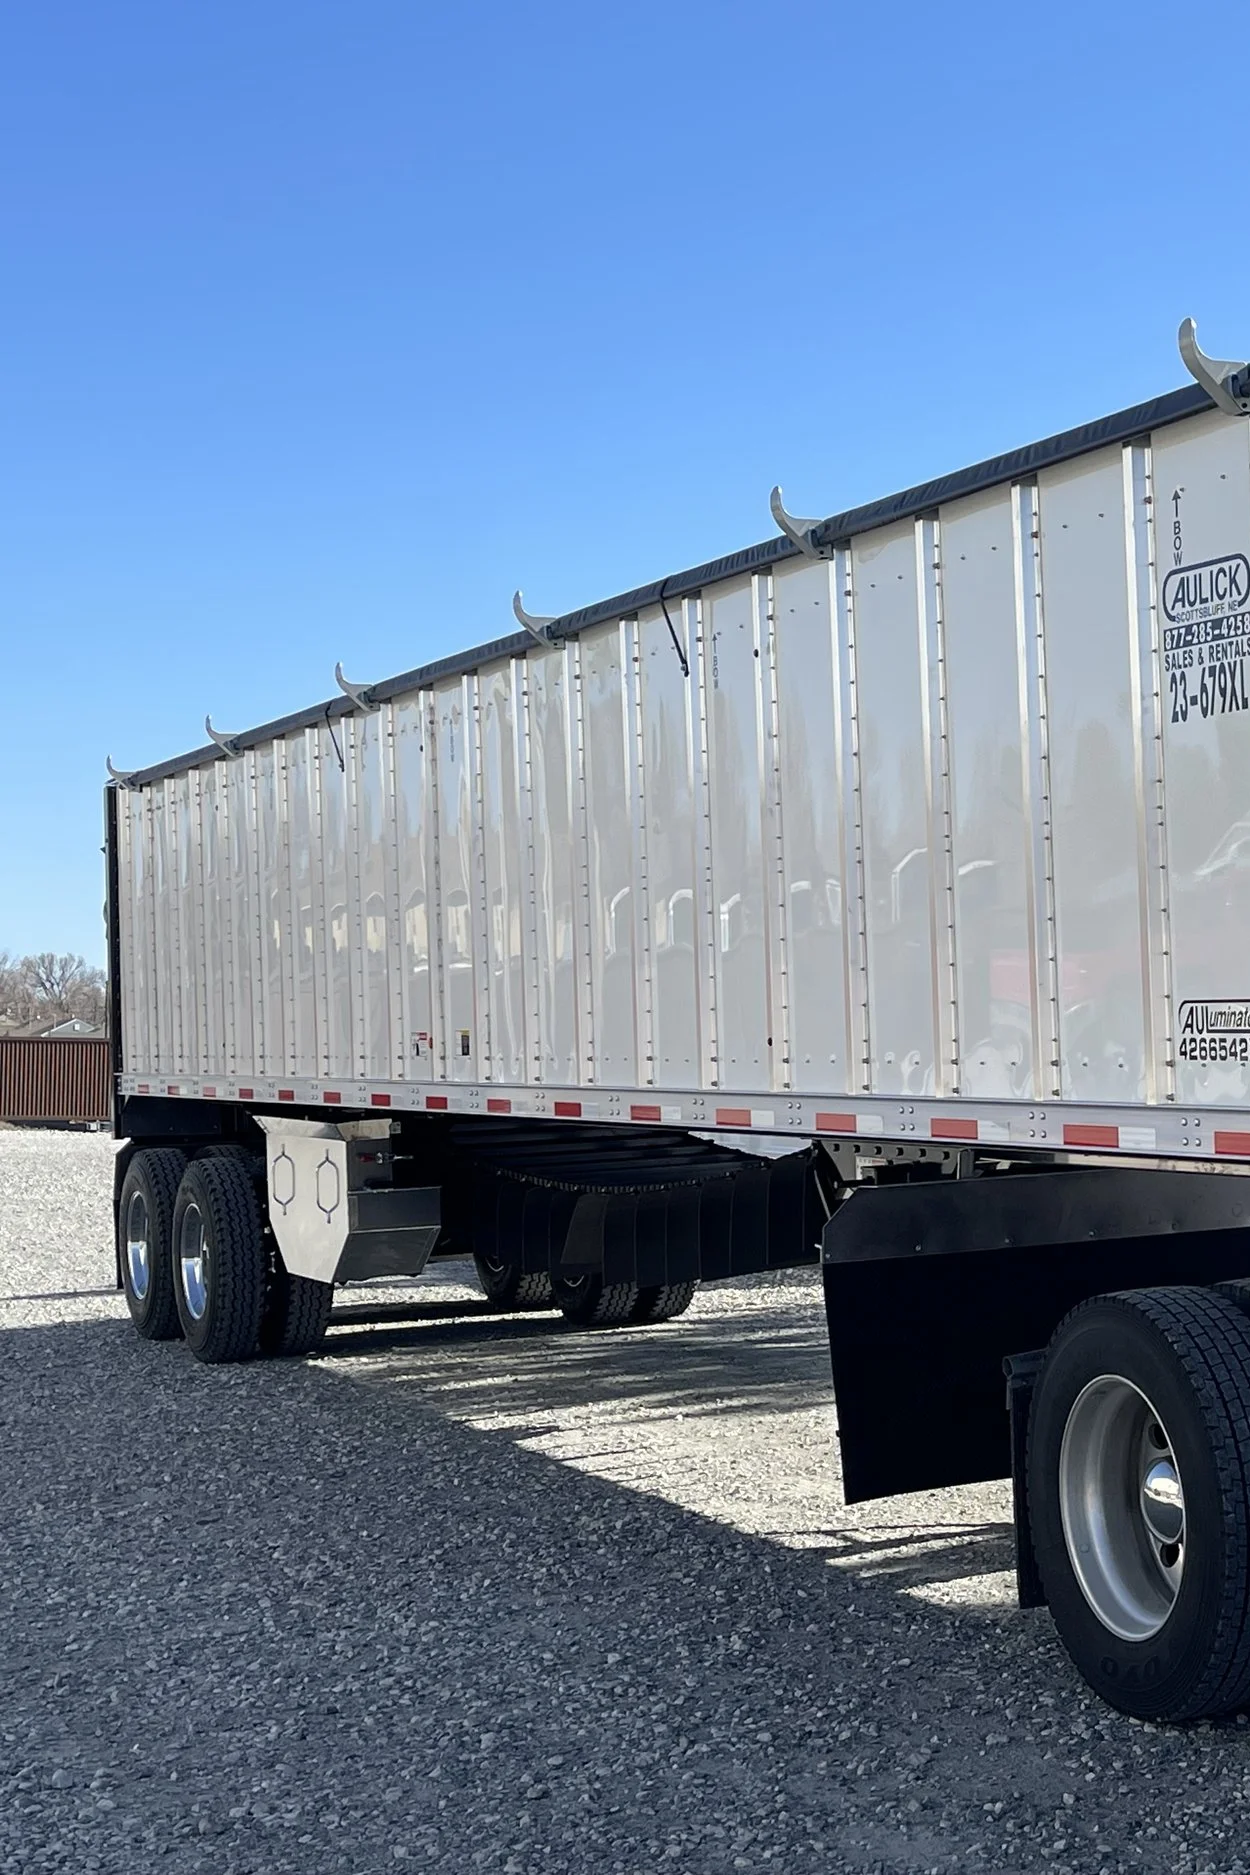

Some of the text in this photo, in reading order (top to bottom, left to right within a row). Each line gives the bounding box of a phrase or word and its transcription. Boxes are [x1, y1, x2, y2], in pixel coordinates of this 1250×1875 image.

[1173, 521, 1183, 567] BOW
[1171, 563, 1242, 611] AULICK
[1228, 599, 1238, 612] NE
[1165, 613, 1250, 650] 877-285-4258
[1164, 649, 1194, 672] SALES
[1198, 647, 1204, 666] &
[1170, 659, 1249, 723] 23-679XL
